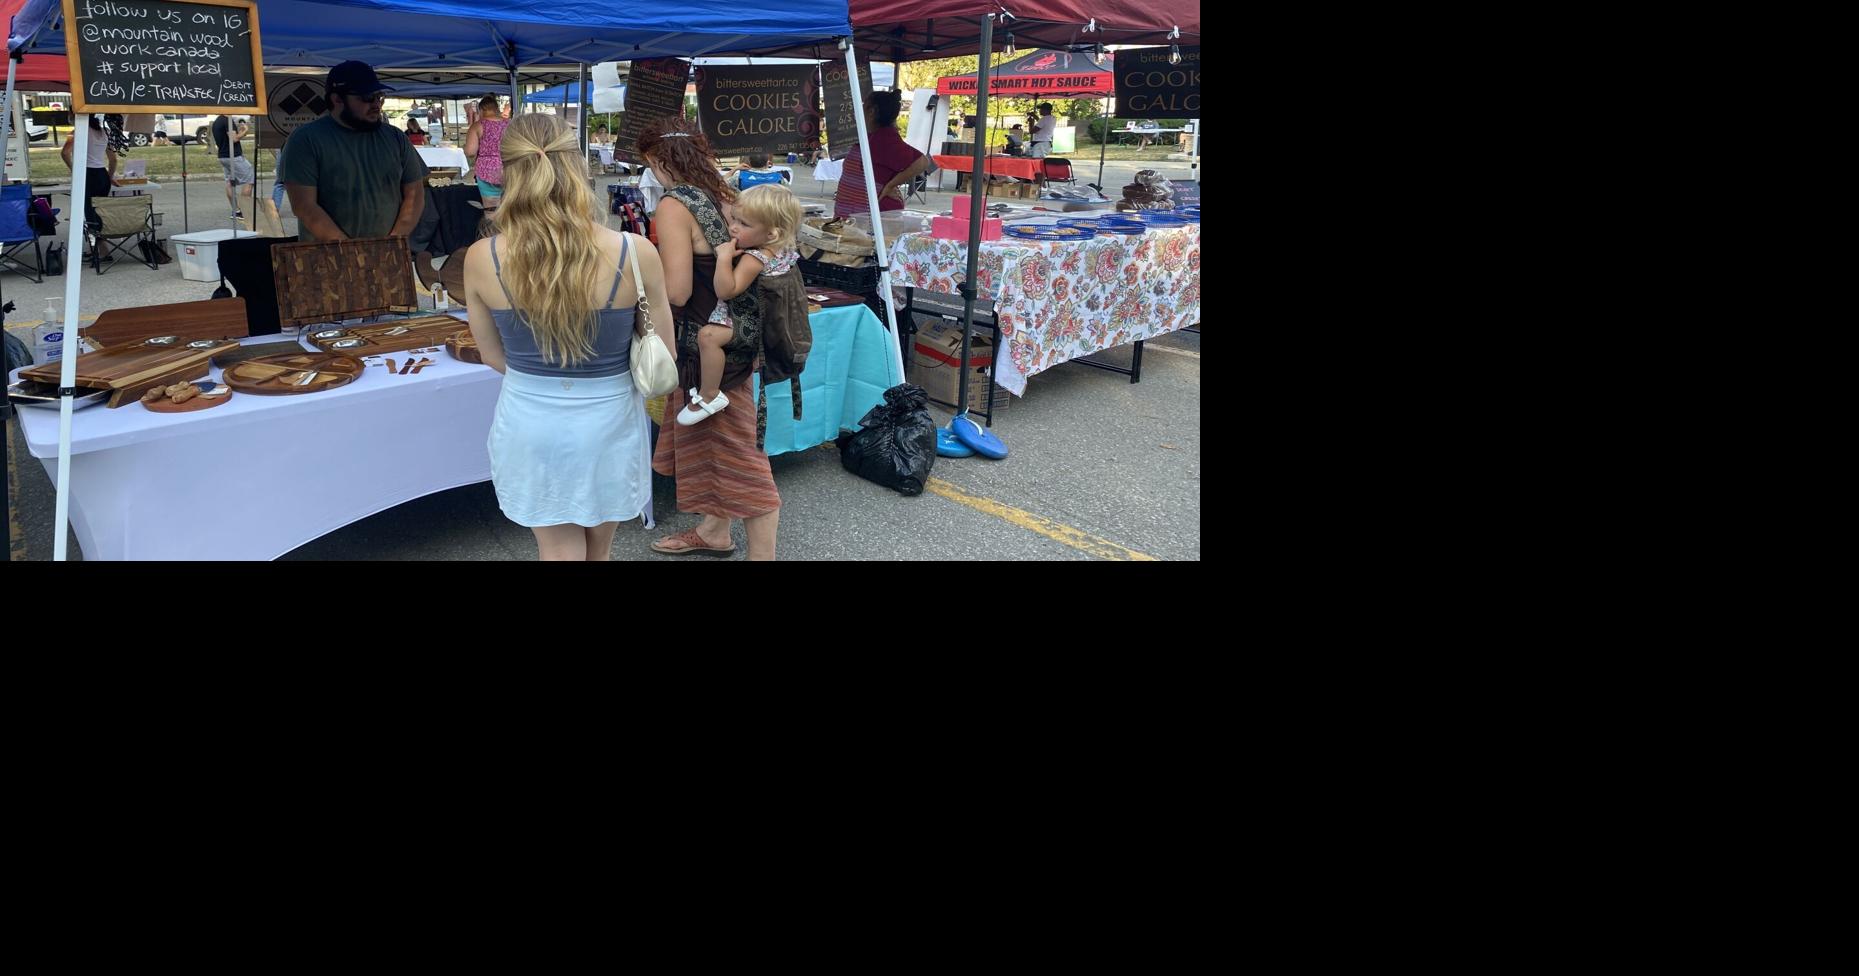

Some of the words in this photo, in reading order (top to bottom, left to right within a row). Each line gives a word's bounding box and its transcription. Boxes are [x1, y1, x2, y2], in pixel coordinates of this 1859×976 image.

[76, 0, 147, 19] follow
[157, 9, 182, 23] us
[192, 13, 215, 25] on
[82, 24, 183, 42] @mountain
[190, 33, 233, 48] wood
[100, 44, 151, 55] work
[156, 46, 221, 59] canada
[120, 61, 181, 79] support
[187, 62, 221, 77] local
[949, 80, 979, 91] WICK
[991, 79, 1028, 89] SMART
[1032, 78, 1053, 88] HOT
[1056, 77, 1096, 87] SAUCE
[223, 91, 253, 102] CREDIT
[713, 92, 800, 112] COOKIES
[717, 116, 796, 136] GALORE
